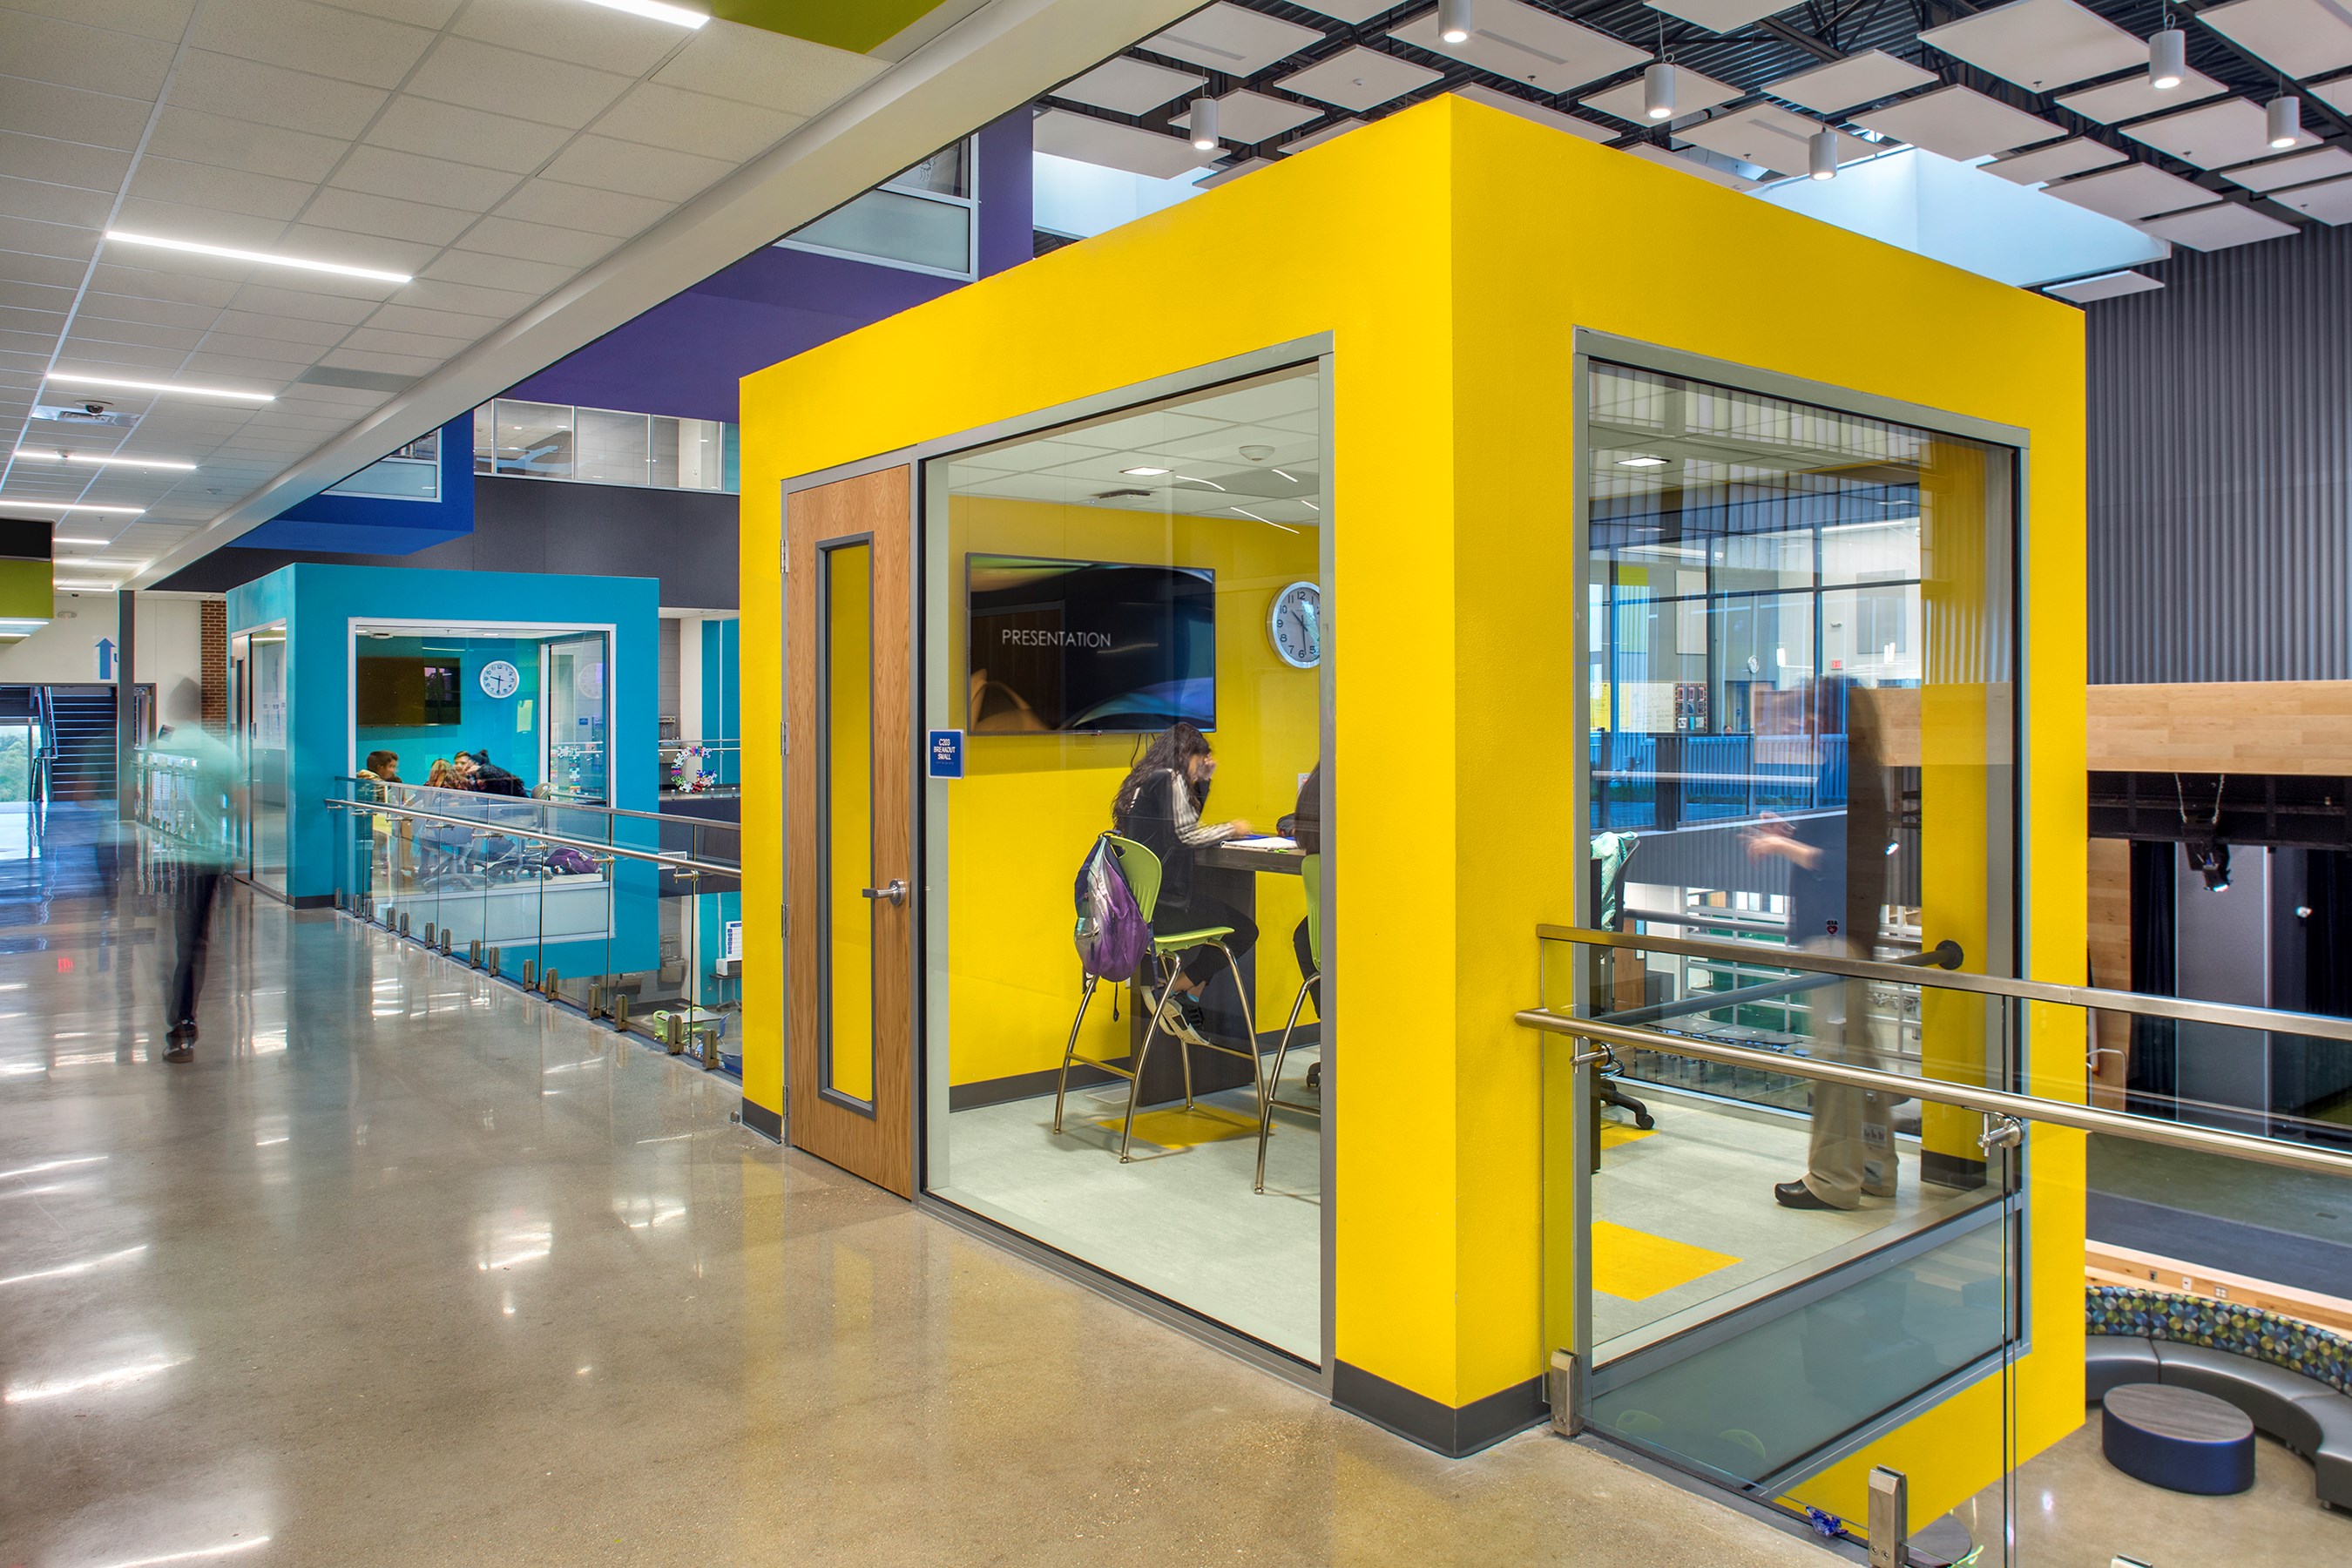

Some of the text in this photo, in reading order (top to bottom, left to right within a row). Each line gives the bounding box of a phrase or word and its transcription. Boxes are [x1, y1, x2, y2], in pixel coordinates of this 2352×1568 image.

[1288, 595, 1294, 604] 11
[1297, 591, 1306, 600] 12
[1280, 605, 1288, 614] 10
[1277, 619, 1283, 628] 9
[1002, 629, 1111, 648] PRESENTATION
[1280, 633, 1288, 643] 8
[1288, 645, 1294, 654] 7
[1309, 645, 1316, 654] 5
[1298, 650, 1305, 659] 6
